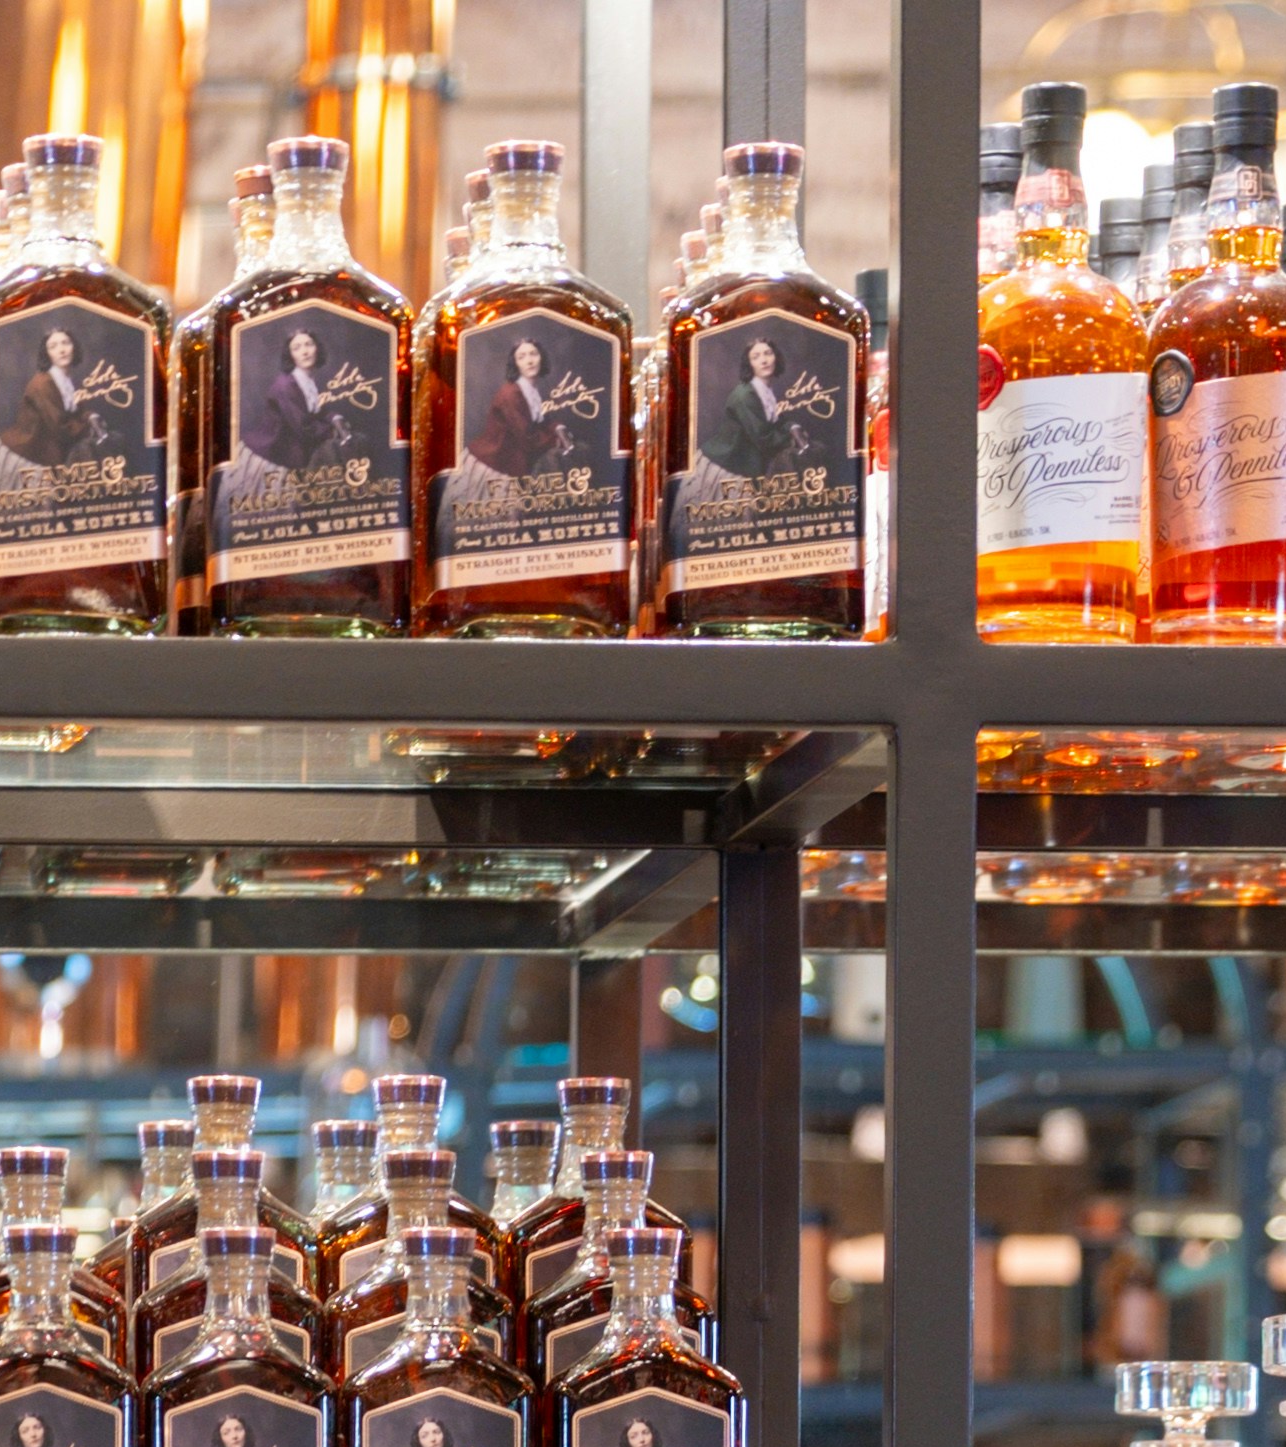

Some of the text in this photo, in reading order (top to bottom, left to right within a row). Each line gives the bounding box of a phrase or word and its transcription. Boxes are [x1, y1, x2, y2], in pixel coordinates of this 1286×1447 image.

[785, 371, 822, 399] Lola
[19, 455, 126, 489] FAME &
[265, 457, 370, 490] FAME &
[487, 467, 592, 499] FAME &
[721, 466, 827, 500] FAME &
[985, 445, 1130, 509] & Penniless
[1173, 466, 1197, 500] &
[231, 478, 402, 515] MISFORTUNE
[452, 486, 623, 521] MISFORTUNE
[685, 485, 858, 524] MISFORTUNE
[18, 510, 155, 539] LOLA MONTEZ
[262, 511, 399, 541] LOLA MONTEZ
[484, 521, 619, 548] LOLA MONTEZ
[718, 520, 856, 549] LOLA MONTEZ
[60, 541, 86, 555] RYE
[89, 535, 149, 551] WHISKEY
[233, 536, 394, 564] STRAIGHT RYE WHISKEY
[456, 545, 614, 571] STRAIGHT RYE WHISKEY
[690, 545, 850, 573] STRAIGHT RYE WHISKEY
